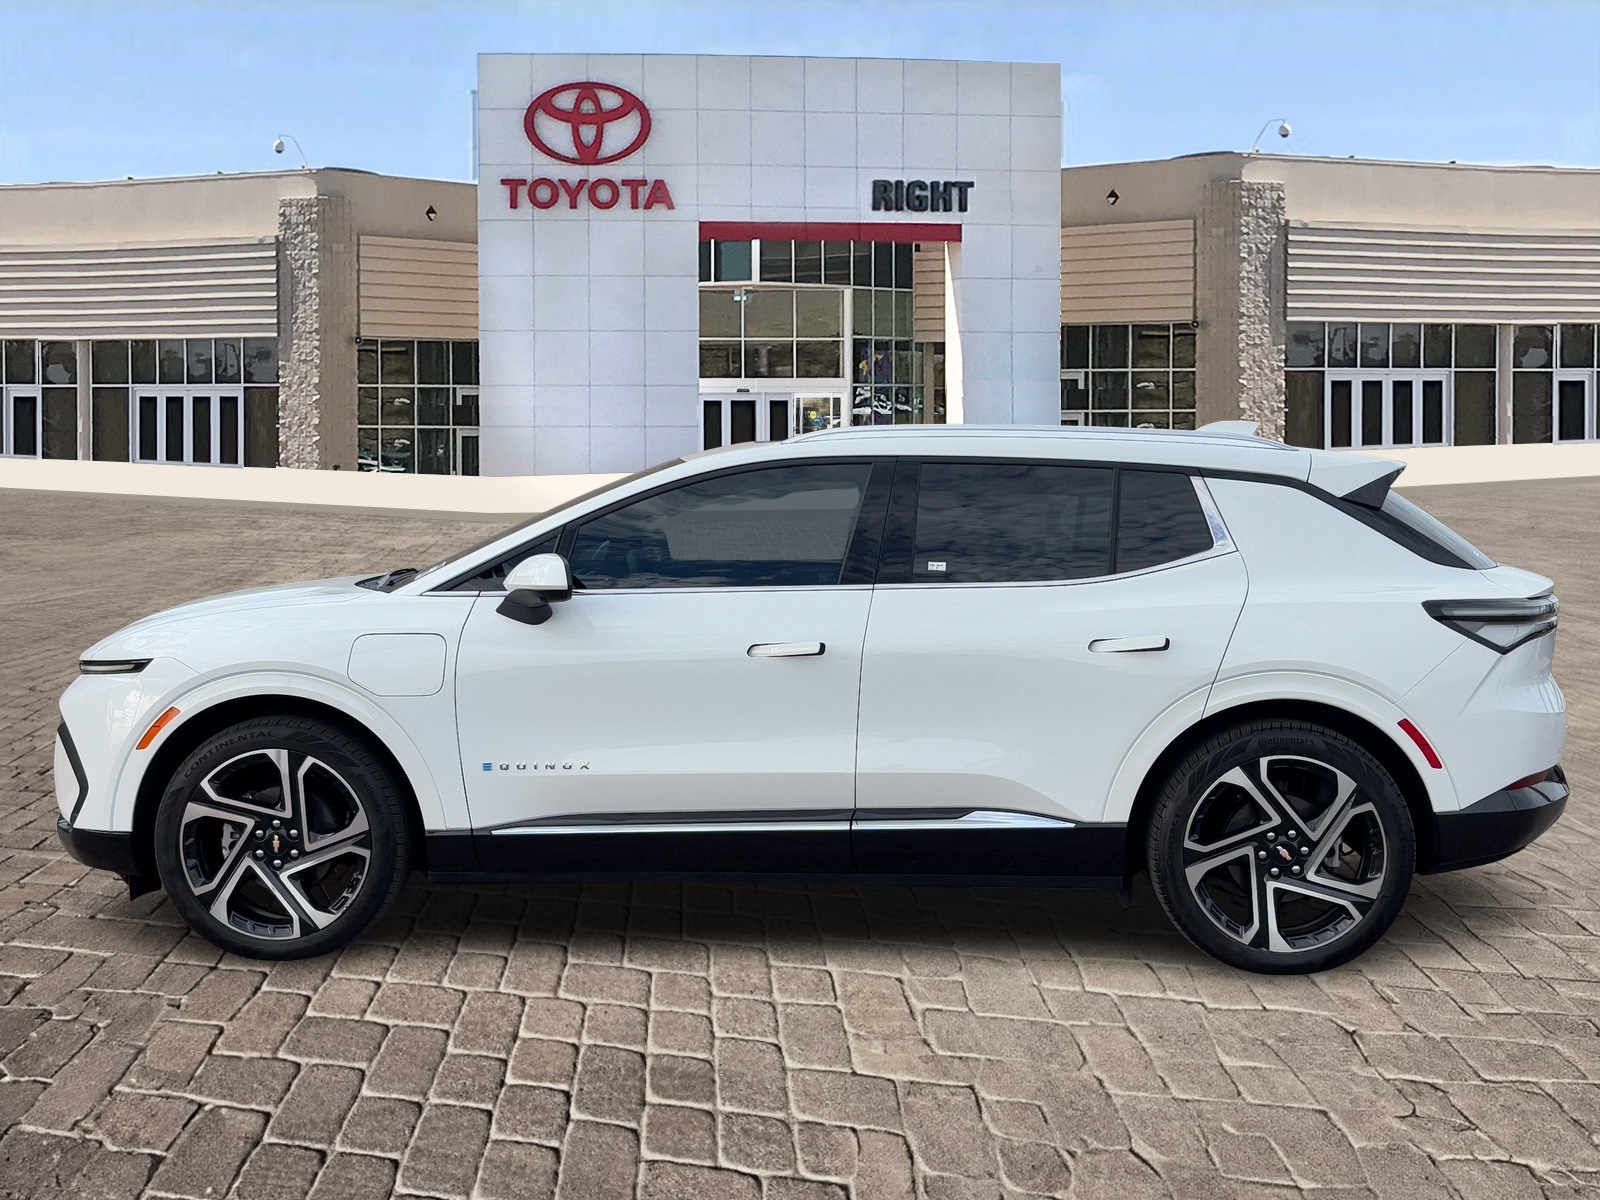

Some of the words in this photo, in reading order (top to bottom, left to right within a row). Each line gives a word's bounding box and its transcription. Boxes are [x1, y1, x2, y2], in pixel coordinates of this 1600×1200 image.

[500, 178, 675, 210] TOYOTA
[872, 179, 975, 212] RIGHT
[184, 730, 274, 778] CONTINENTAL
[1258, 736, 1308, 747] Continental
[482, 761, 590, 772] EQUINOX
